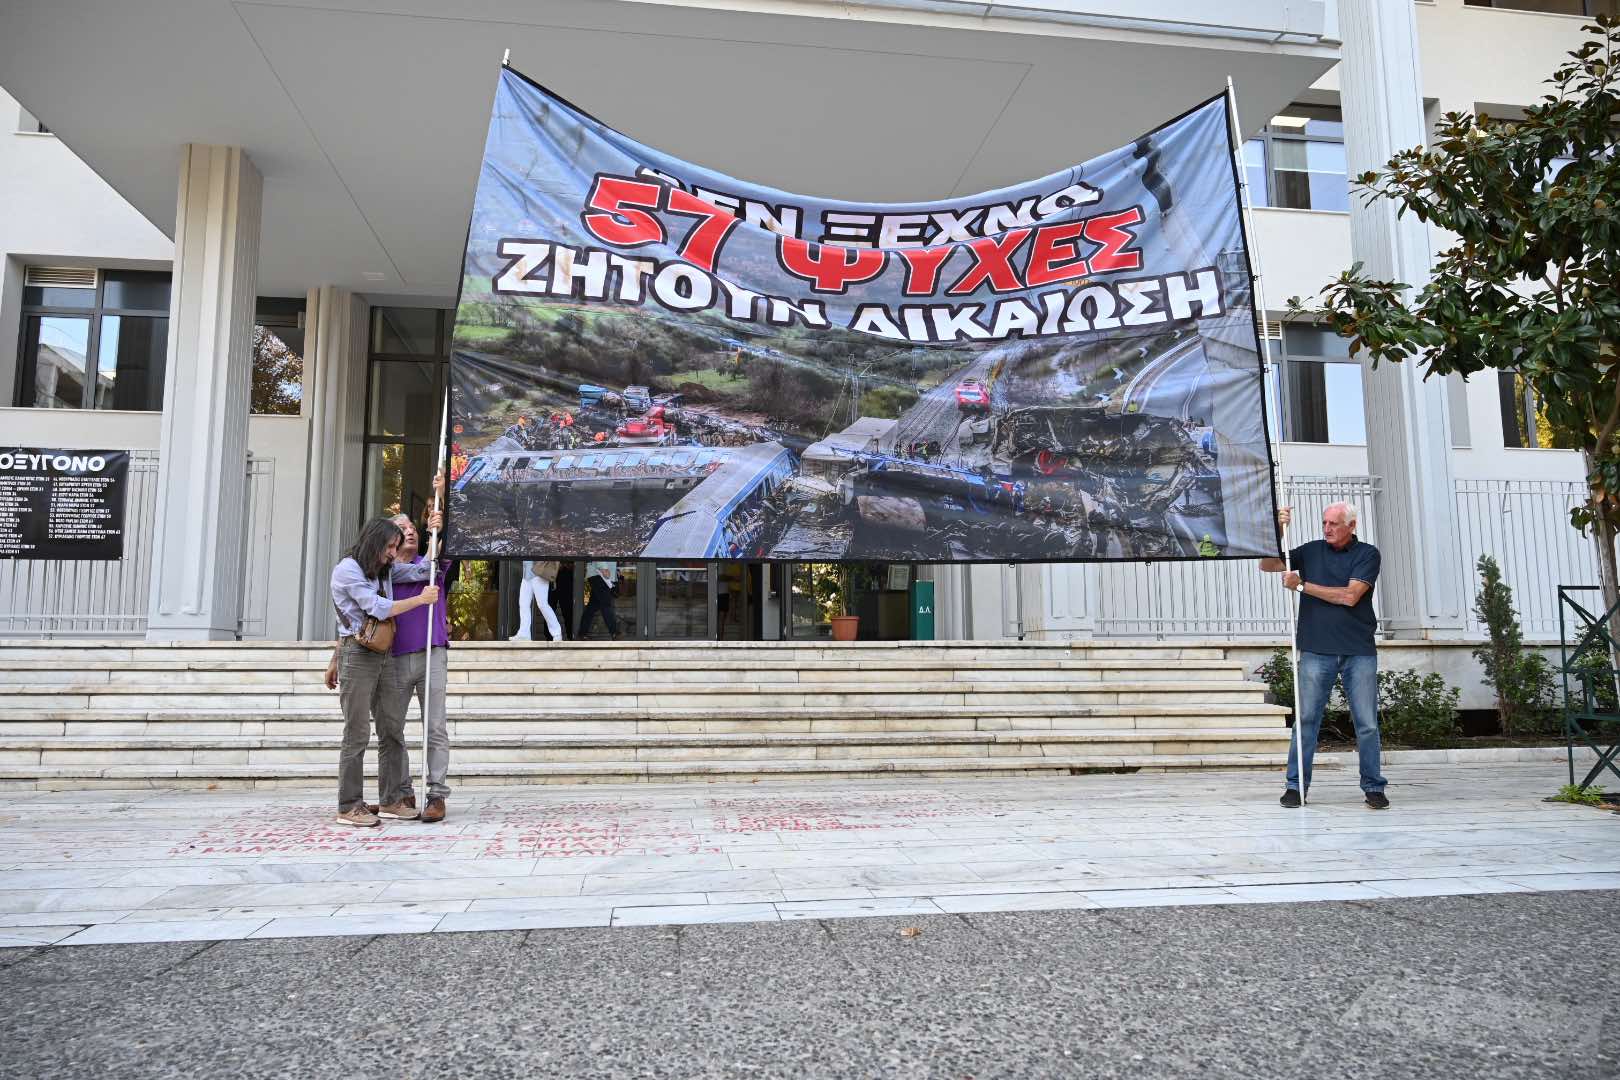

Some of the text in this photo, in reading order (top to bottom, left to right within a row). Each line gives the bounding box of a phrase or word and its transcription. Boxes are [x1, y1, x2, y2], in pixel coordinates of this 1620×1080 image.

[581, 173, 1145, 297] 57 ΨΥΧΕΣ
[492, 239, 1225, 342] ΖΗΤΟΥΝ ΔΙΚΑΙΩΣΗ
[0, 453, 106, 472] ΟΞΥΓΟΝΟ
